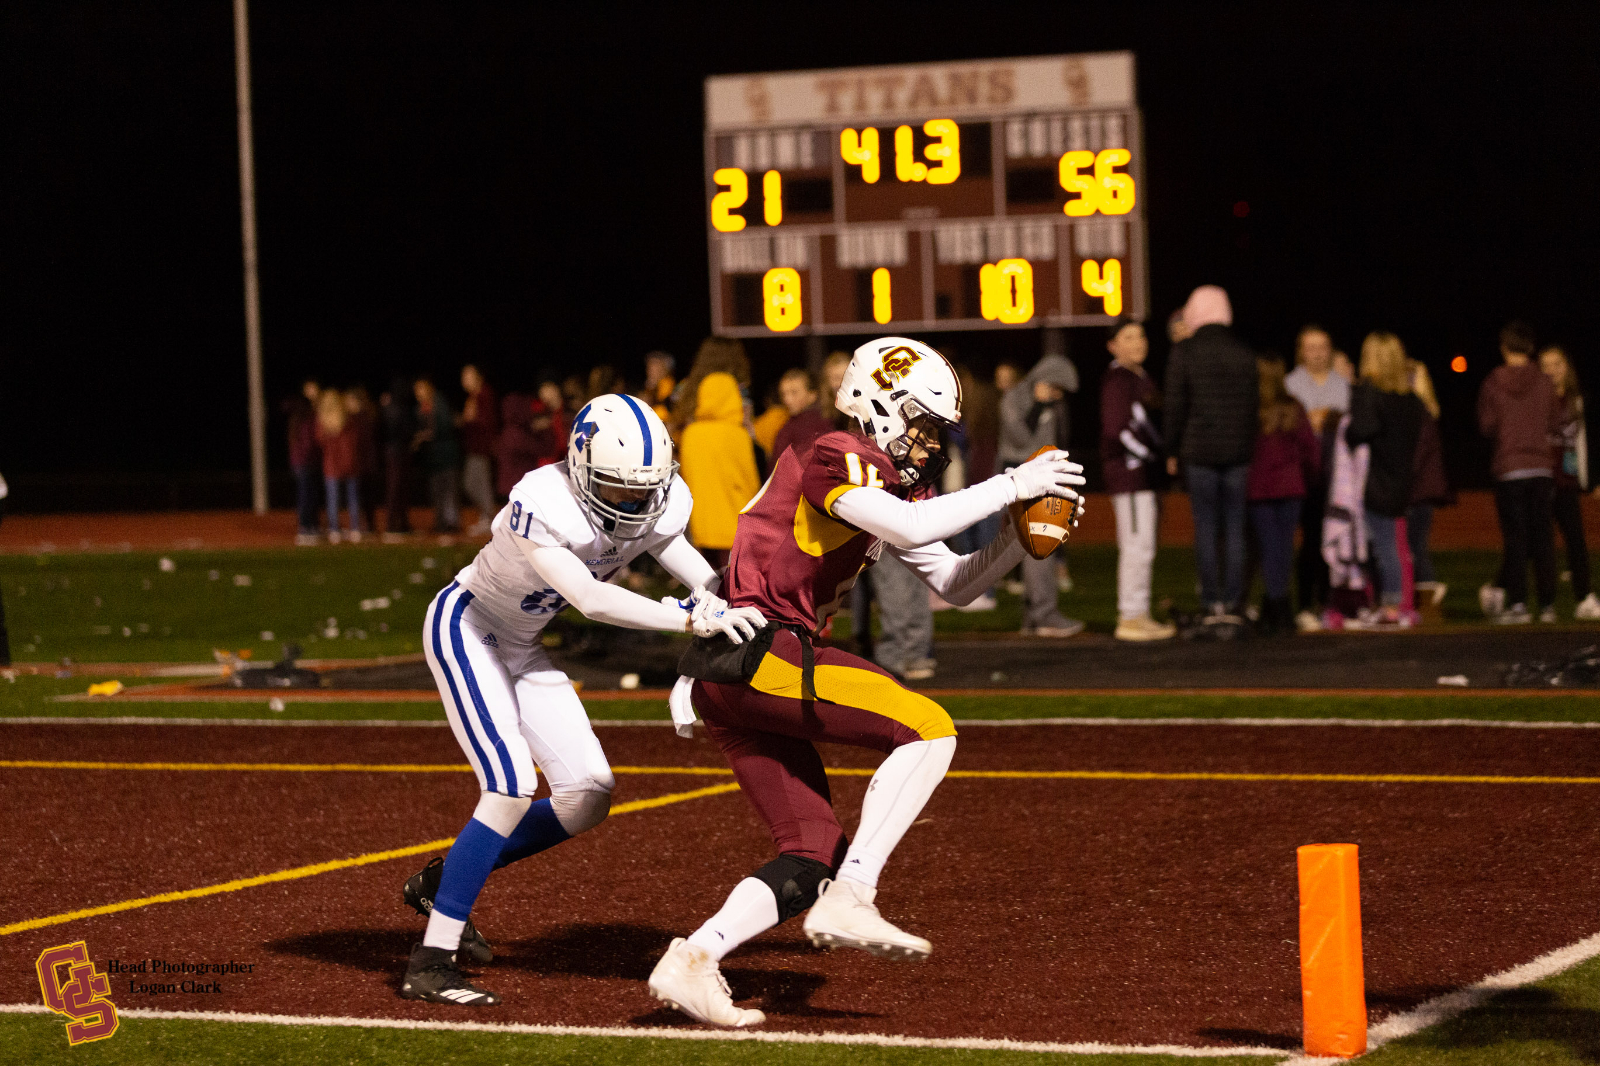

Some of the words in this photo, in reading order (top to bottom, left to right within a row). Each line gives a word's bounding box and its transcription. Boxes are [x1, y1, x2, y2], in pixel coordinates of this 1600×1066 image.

[813, 68, 1016, 114] TITANS
[711, 167, 783, 232] 21
[1058, 148, 1136, 217] 56
[763, 267, 803, 332] 8
[872, 267, 892, 325] 1
[979, 258, 1034, 325] 10
[1081, 258, 1123, 317] 4
[509, 500, 534, 540] 81
[585, 555, 625, 566] MEMORIAL
